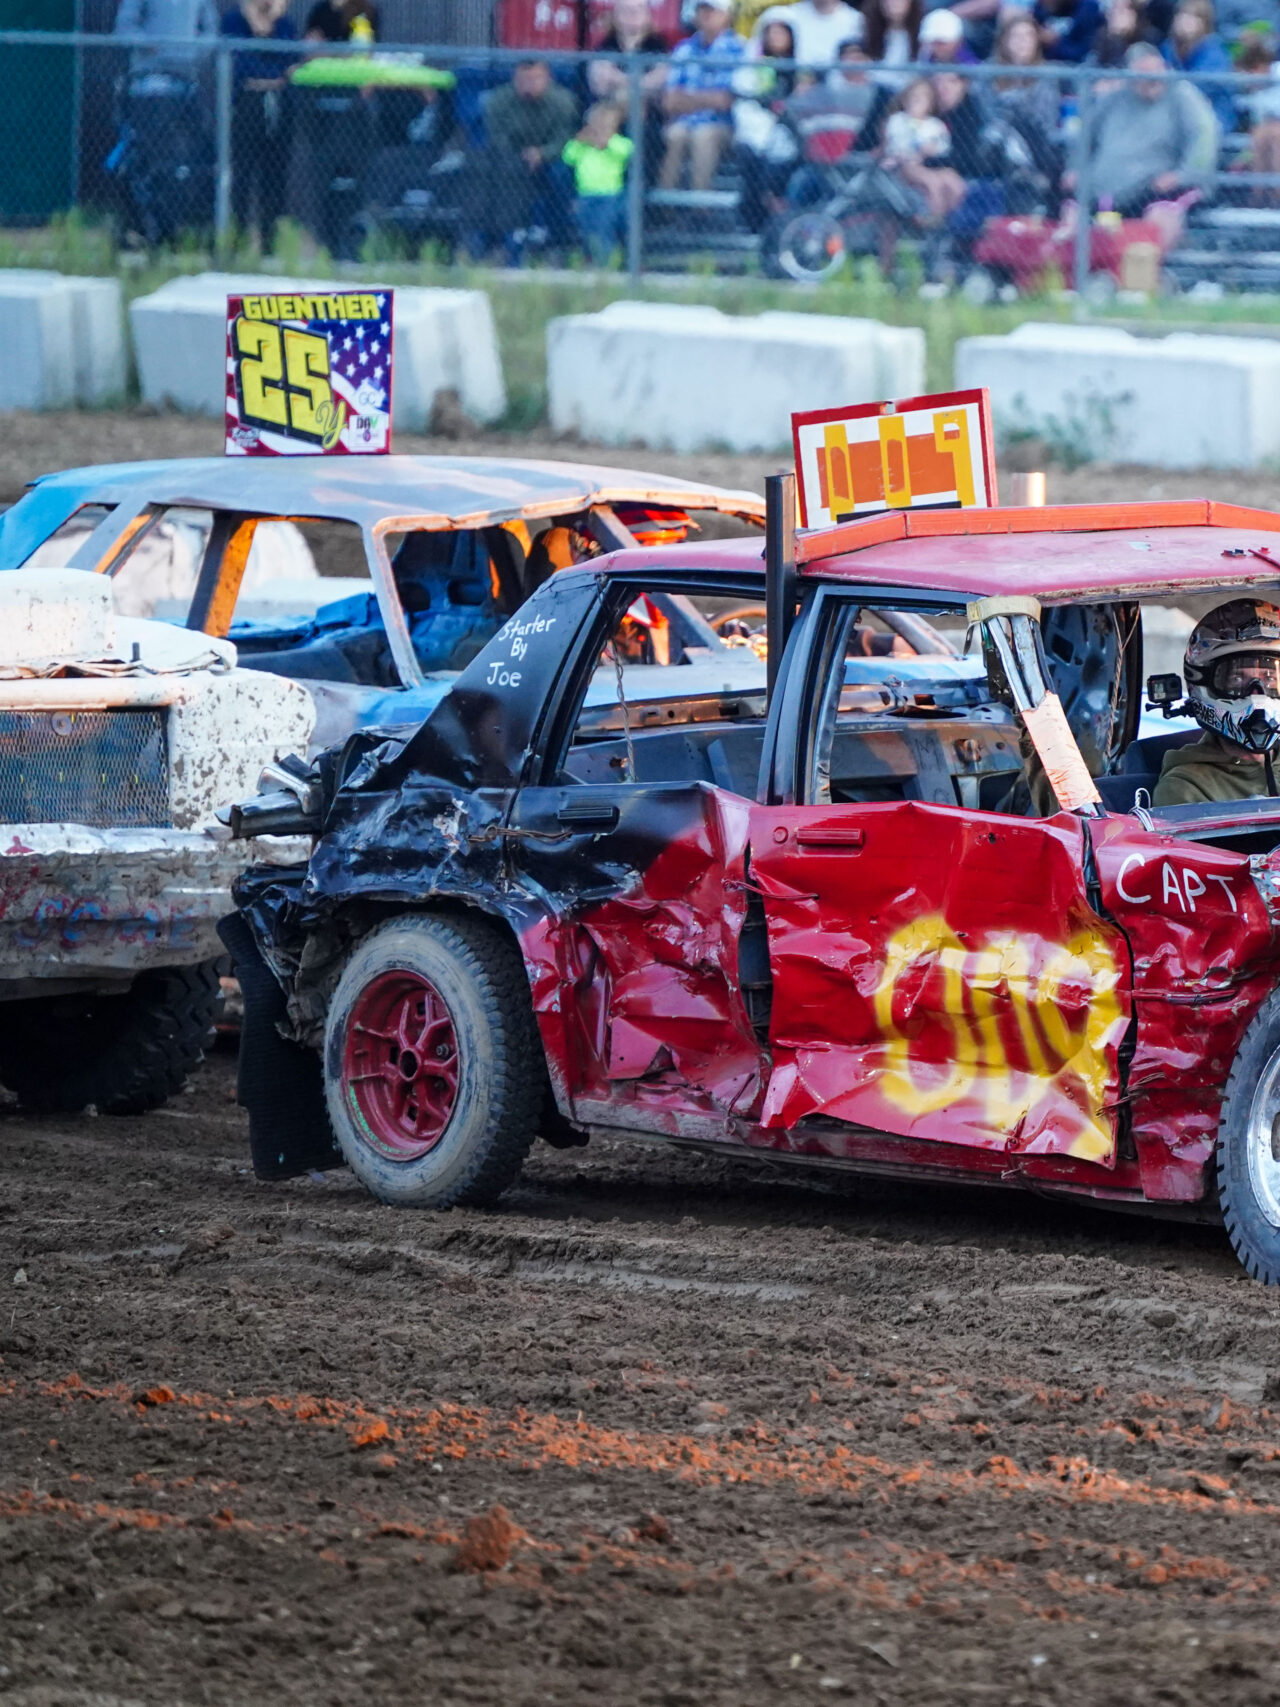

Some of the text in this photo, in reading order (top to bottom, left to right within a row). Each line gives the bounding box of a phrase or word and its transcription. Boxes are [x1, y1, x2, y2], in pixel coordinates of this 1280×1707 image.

[242, 294, 381, 320] GUENTHER
[824, 409, 976, 521] 009
[498, 613, 557, 641] Starter
[510, 637, 528, 661] By
[487, 662, 522, 687] Joe
[1115, 853, 1238, 913] CAPT
